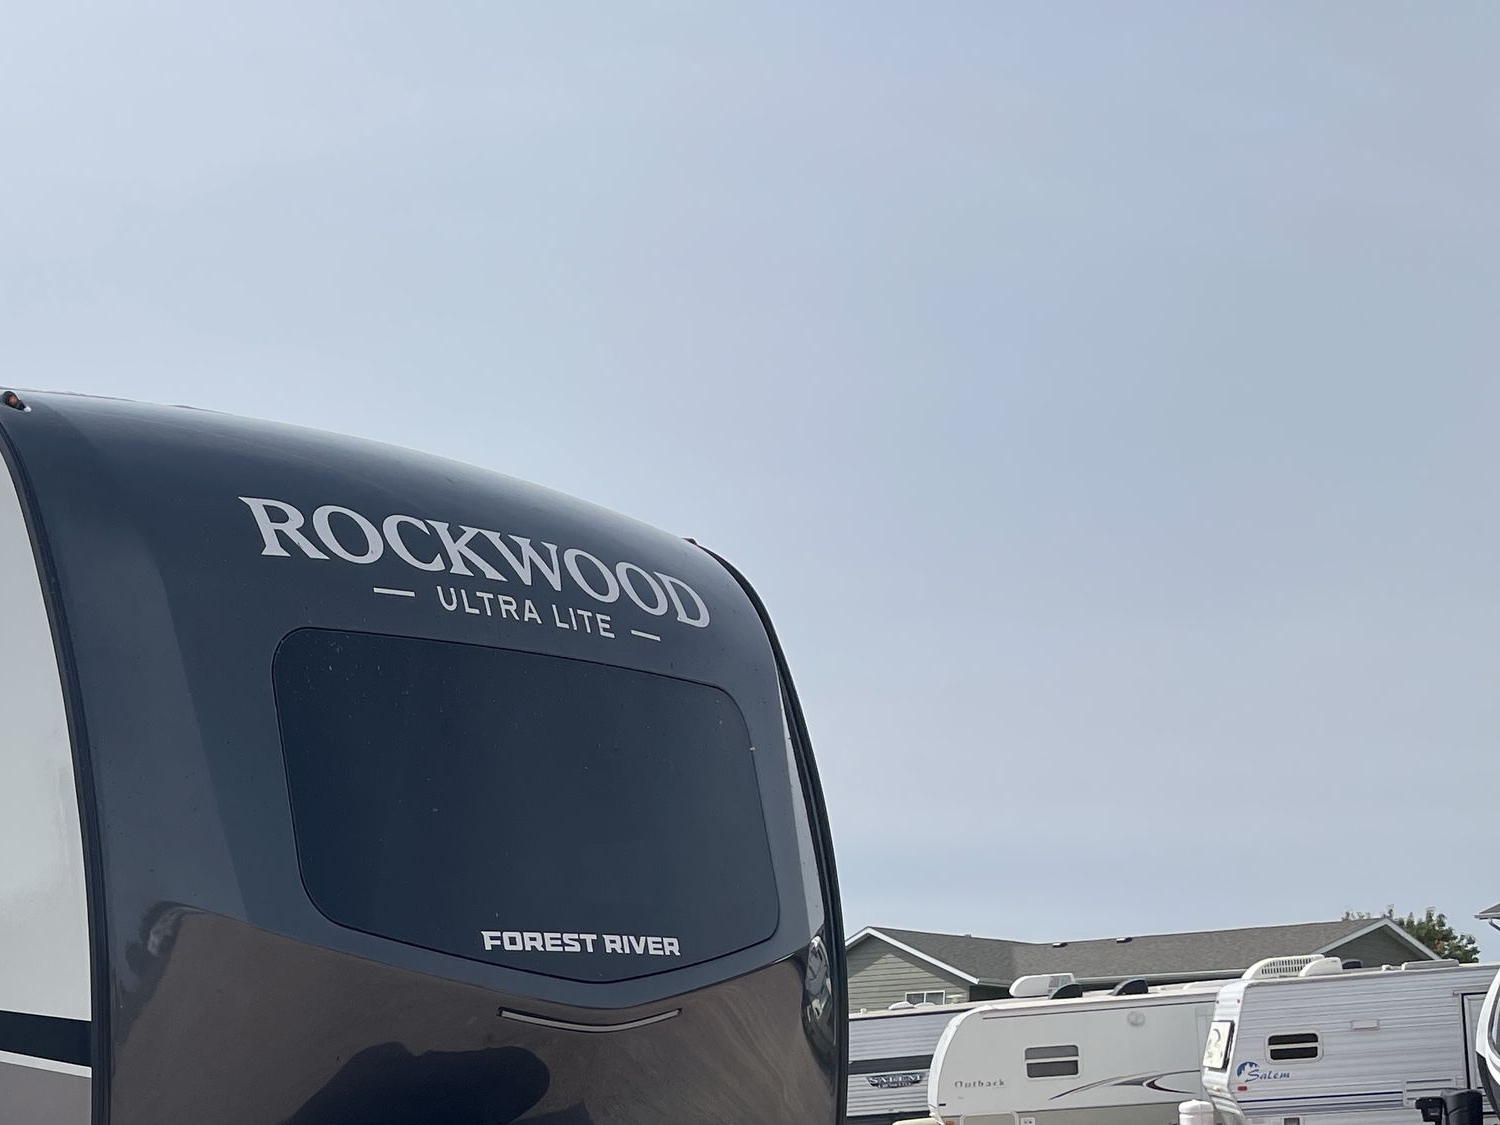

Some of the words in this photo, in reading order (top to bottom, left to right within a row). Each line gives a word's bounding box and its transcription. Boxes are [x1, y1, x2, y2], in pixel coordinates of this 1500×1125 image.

[238, 496, 710, 628] ROCKWOOD
[436, 585, 542, 625] ULTRA
[551, 604, 616, 639] LITE
[481, 931, 597, 953] FOREST
[602, 934, 681, 956] RIVER
[868, 1074, 921, 1085] SALEM
[954, 1079, 1005, 1089] Outback
[1244, 1069, 1290, 1083] Salem
